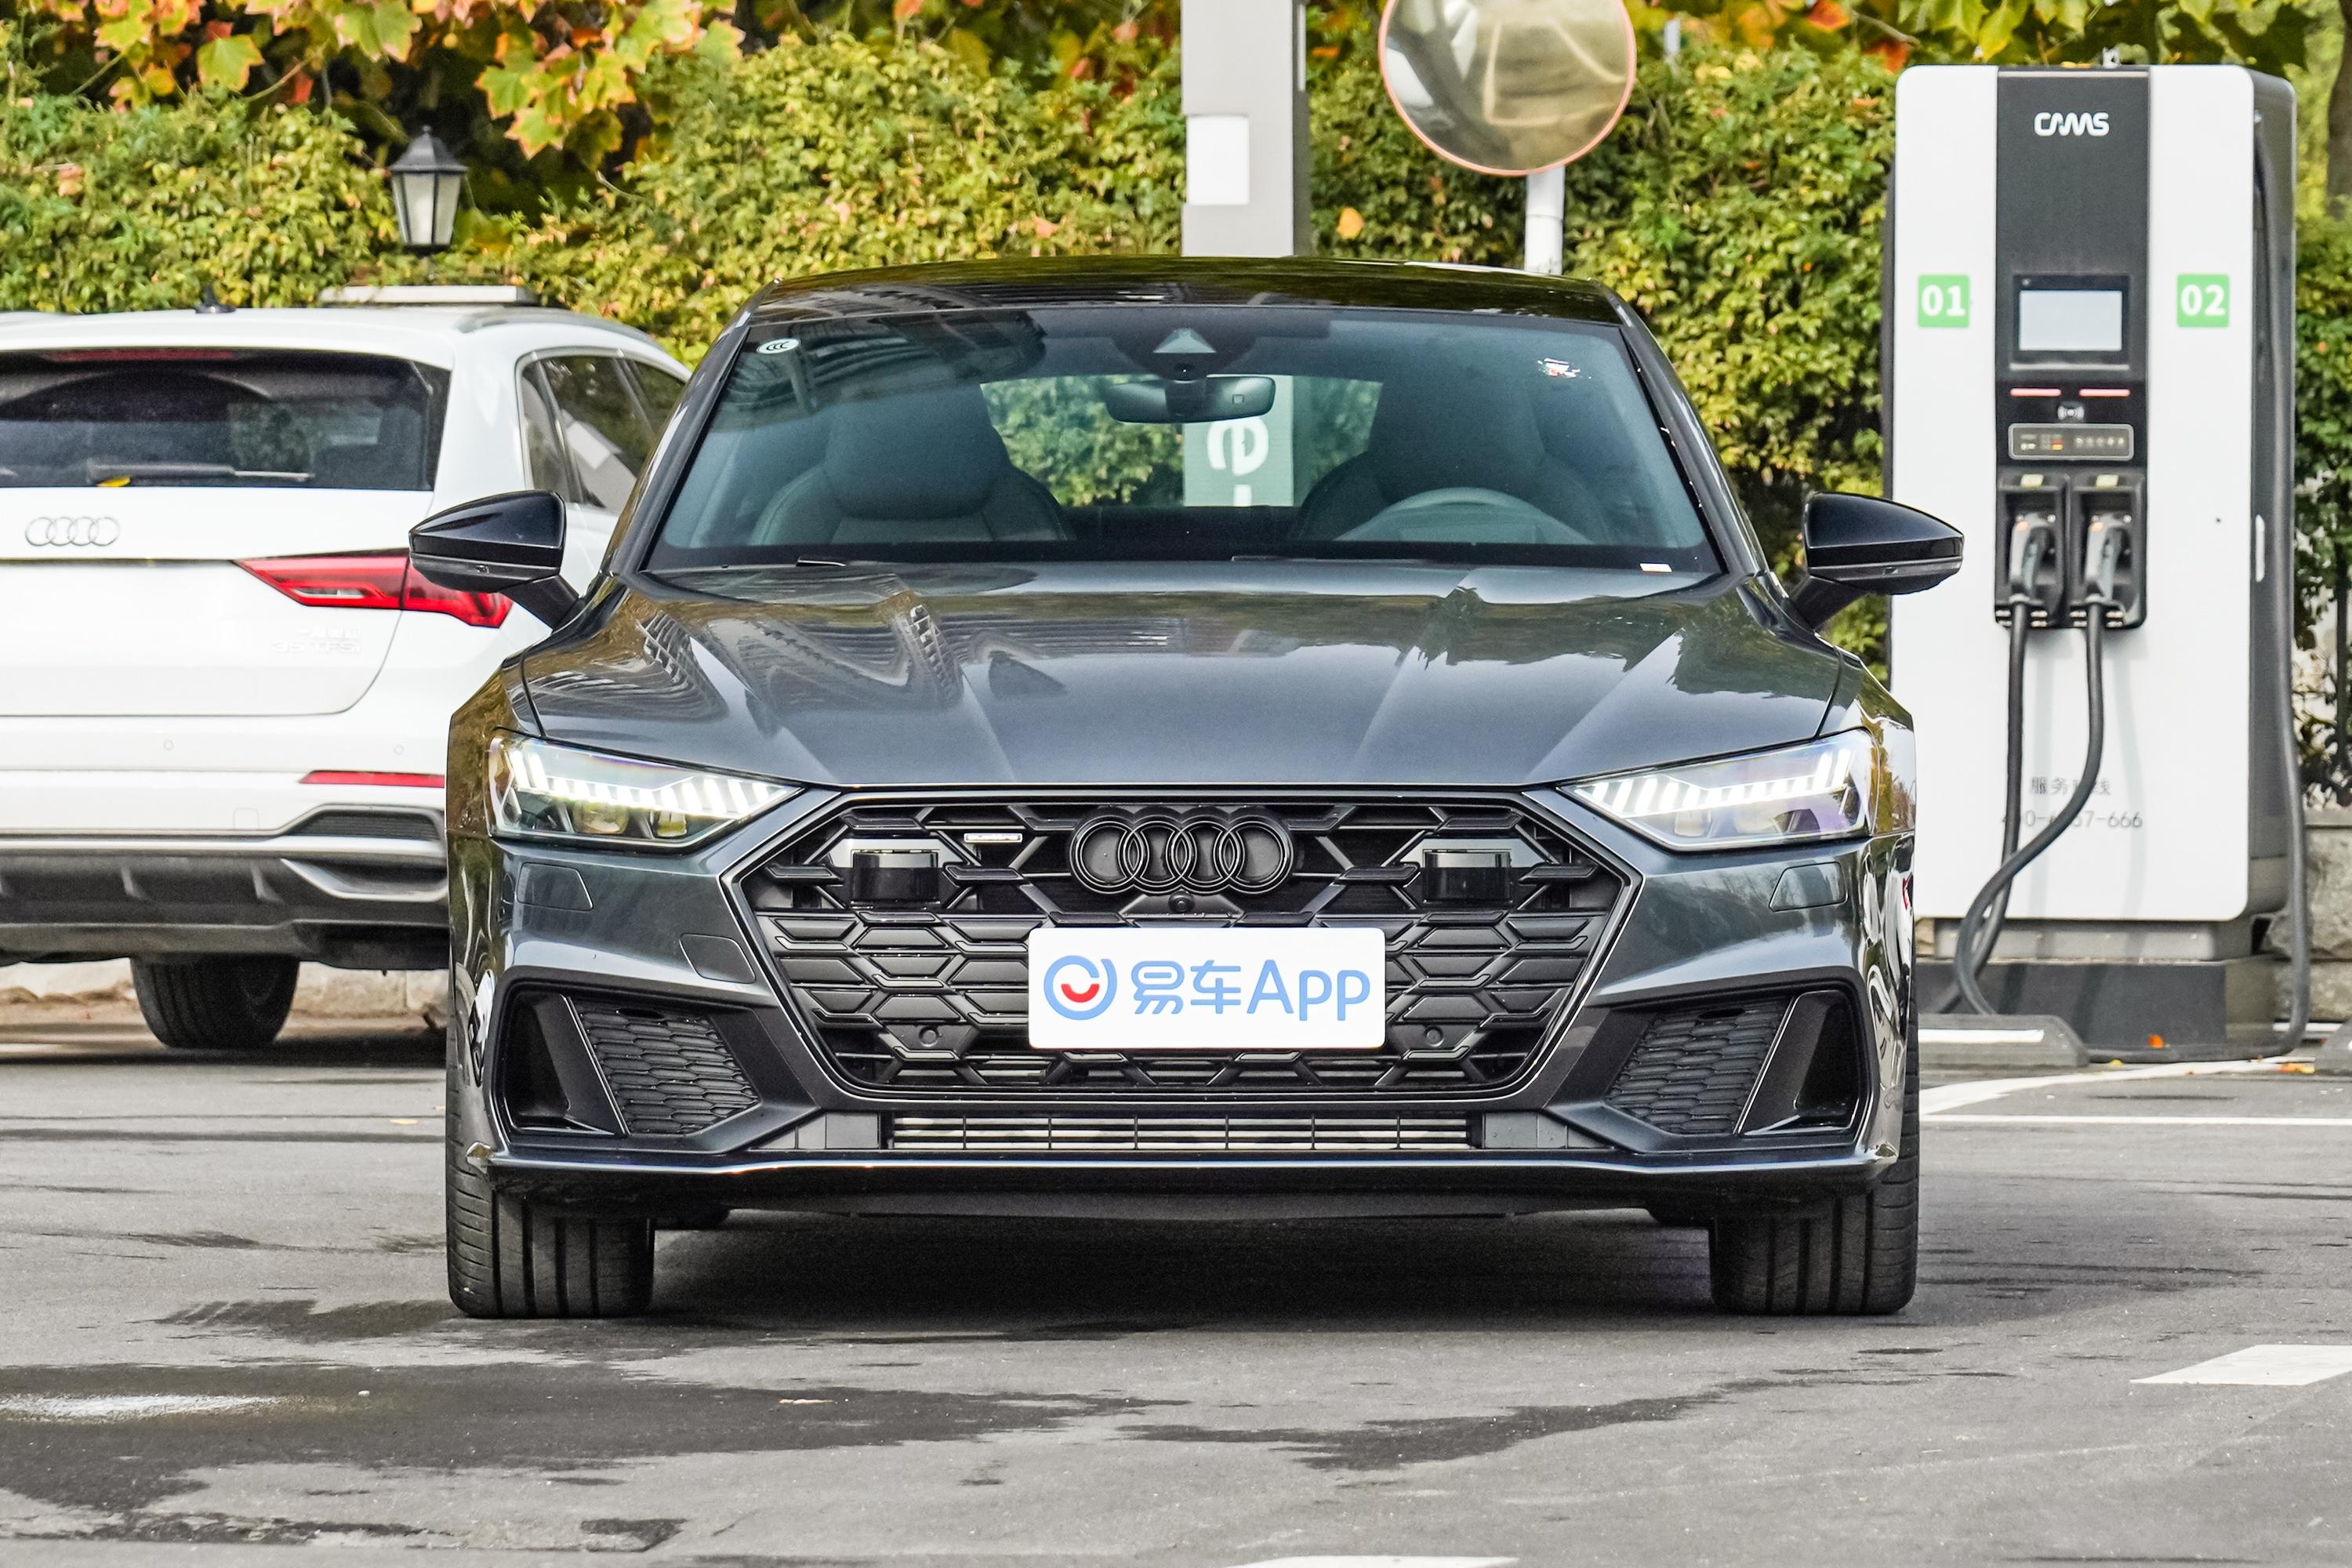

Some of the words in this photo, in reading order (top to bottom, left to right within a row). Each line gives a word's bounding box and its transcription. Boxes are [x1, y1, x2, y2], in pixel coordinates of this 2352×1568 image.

[2034, 111, 2110, 136] CAMS
[1922, 285, 1966, 317] 01
[2180, 285, 2226, 317] 02
[2031, 777, 2112, 795] 服务线
[1131, 959, 1370, 1022] 易车App
